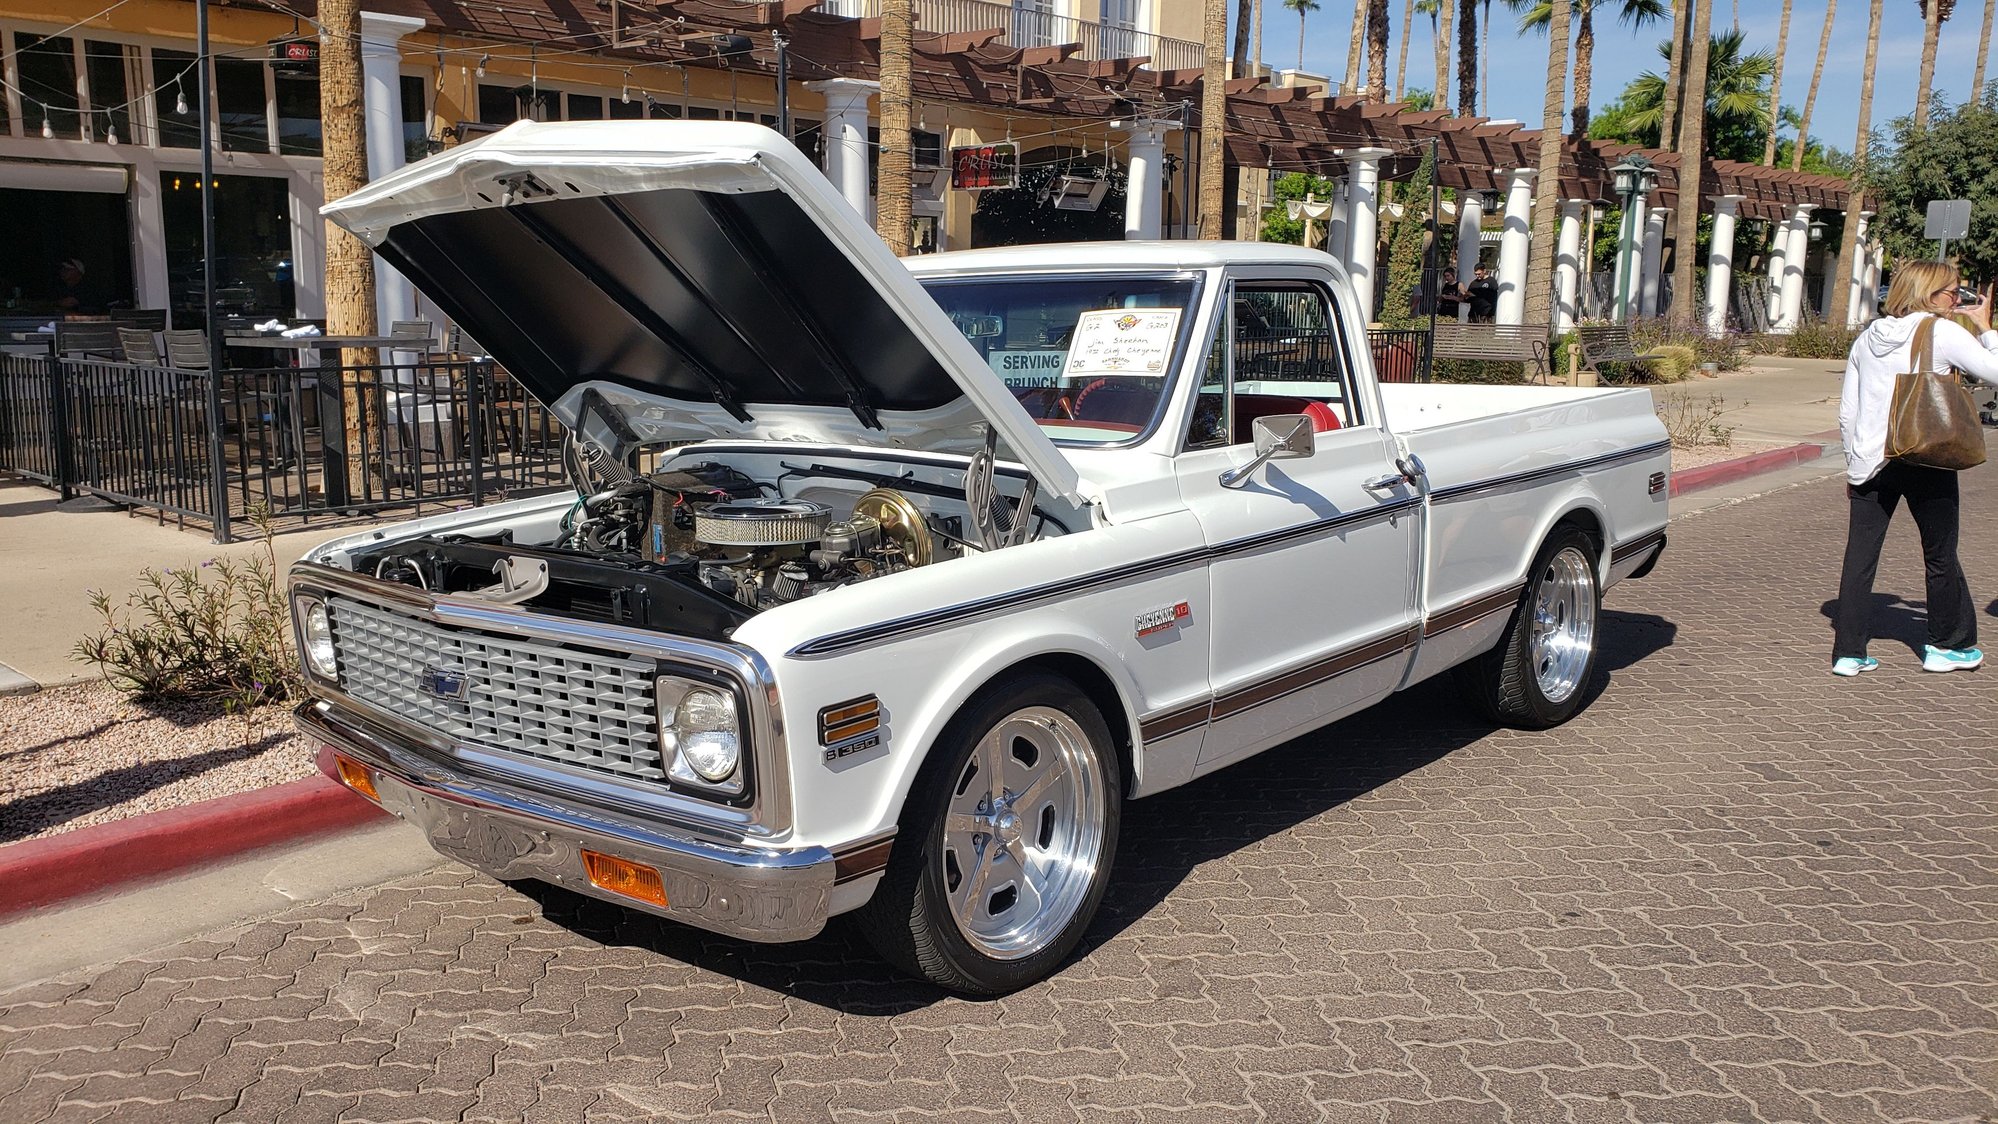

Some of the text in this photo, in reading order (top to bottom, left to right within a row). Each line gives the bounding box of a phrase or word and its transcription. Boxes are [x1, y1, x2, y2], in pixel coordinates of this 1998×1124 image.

[288, 47, 318, 57] CRUST
[958, 152, 1008, 172] CRUST
[1003, 355, 1060, 370] SERVING
[840, 737, 878, 756] 350
